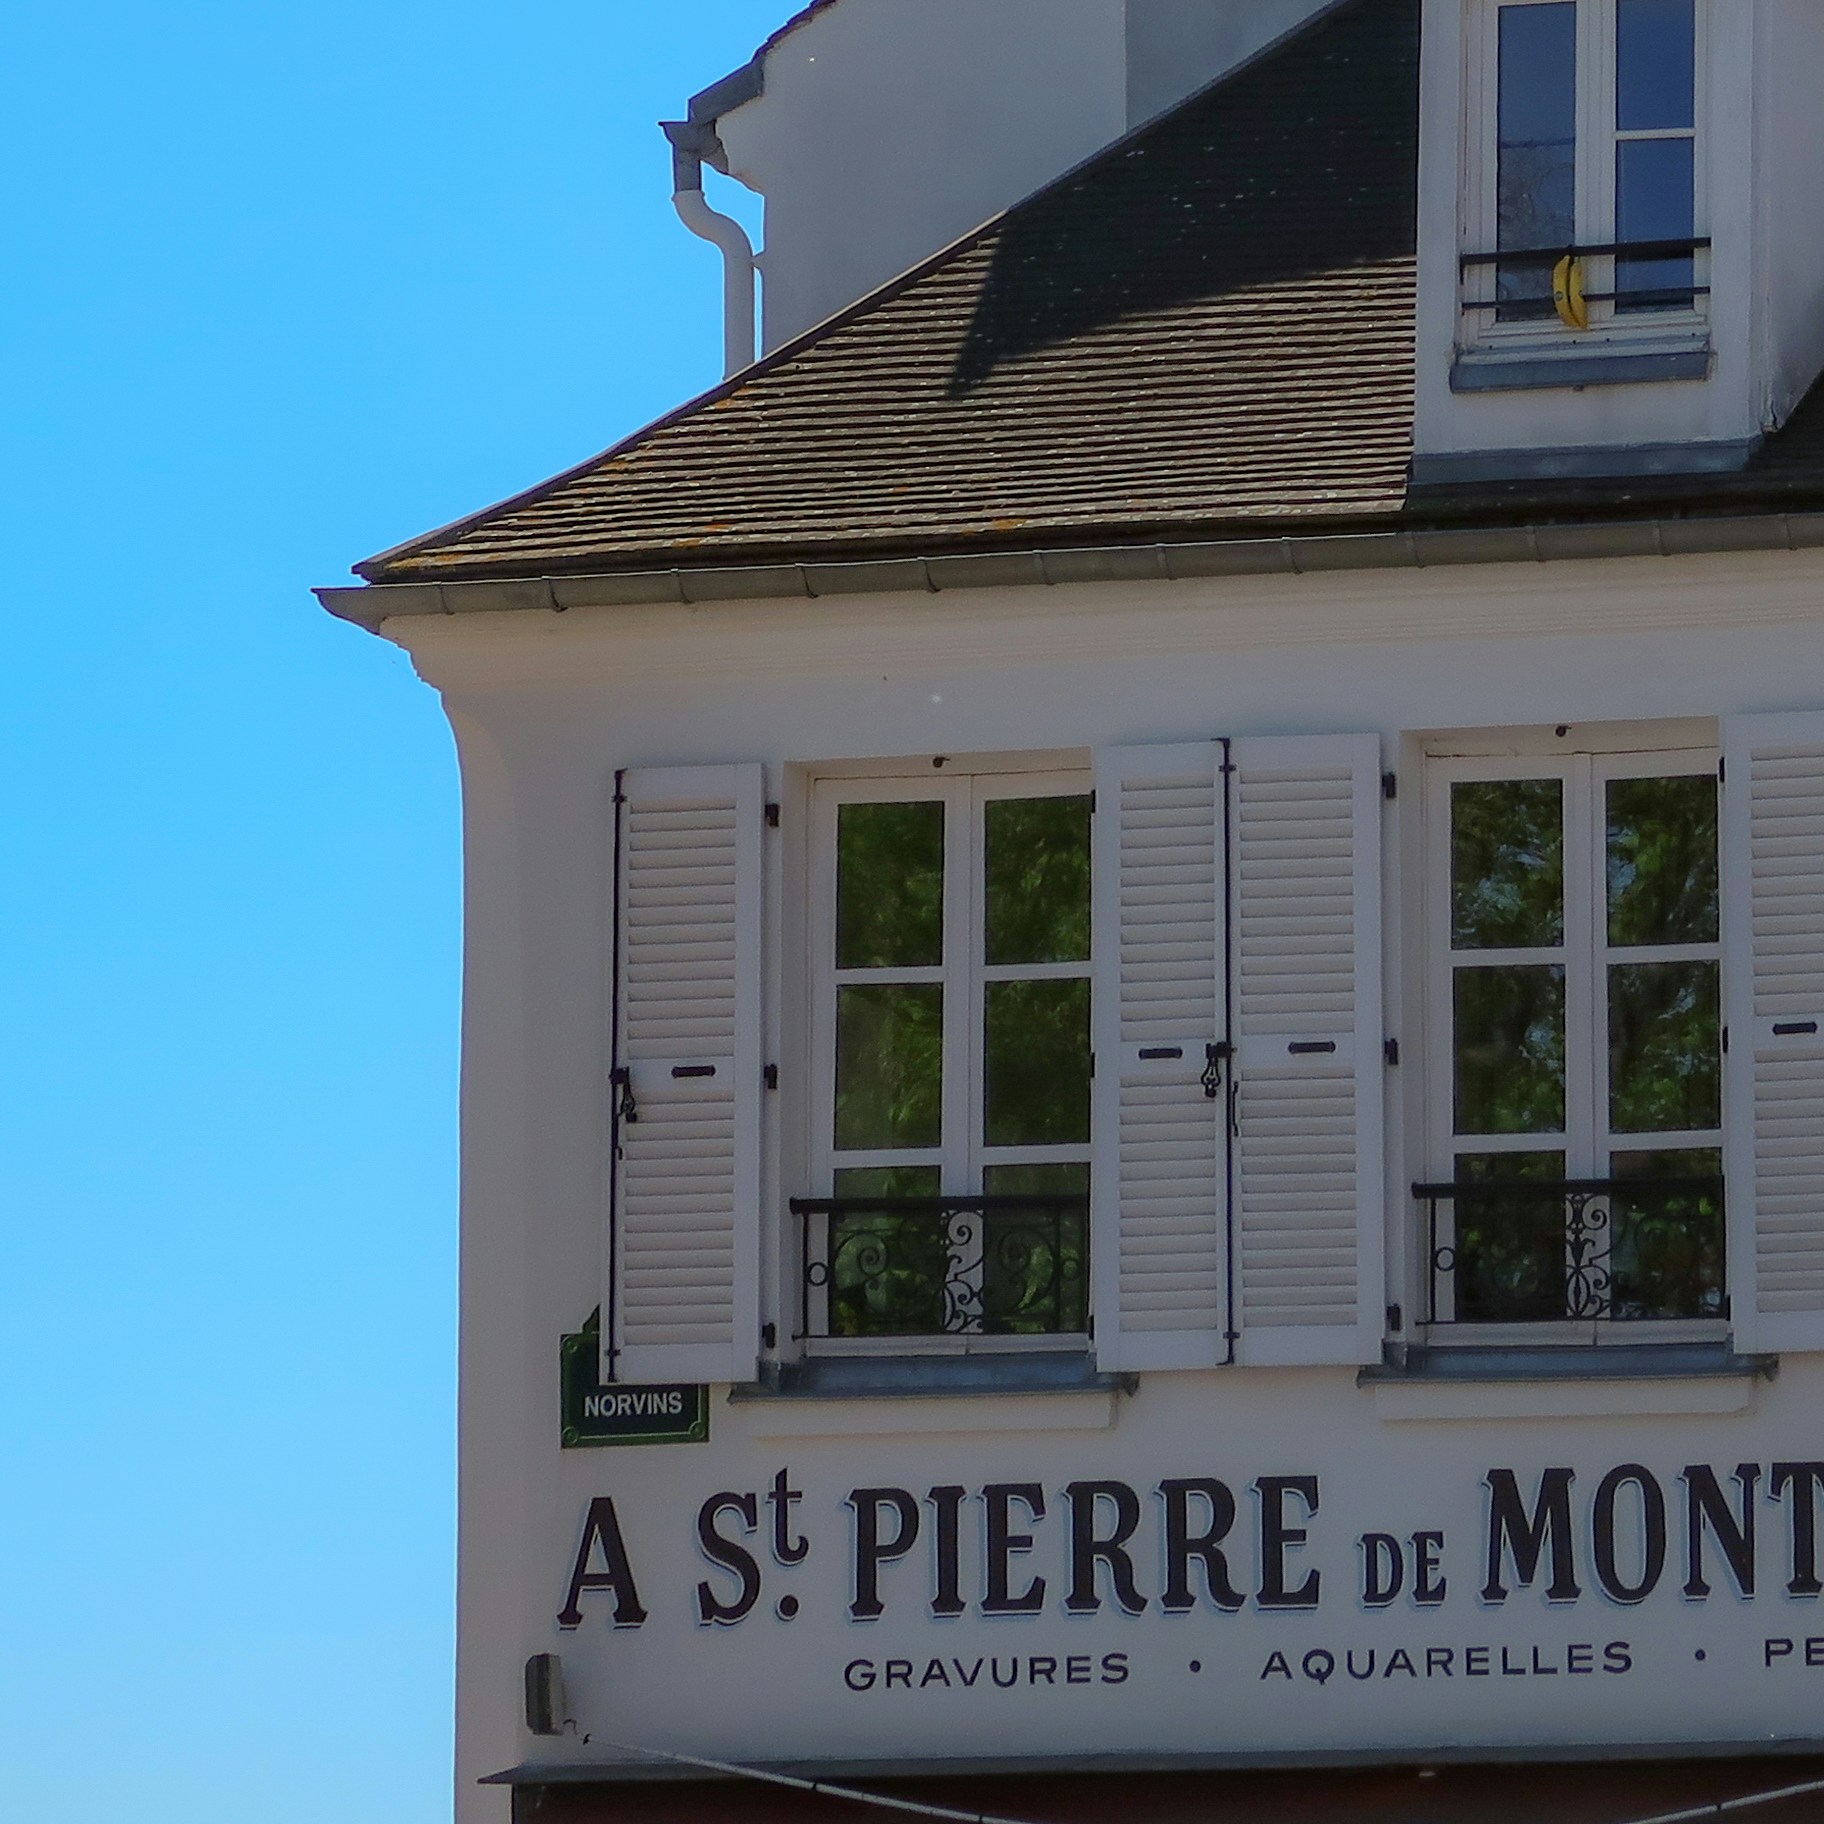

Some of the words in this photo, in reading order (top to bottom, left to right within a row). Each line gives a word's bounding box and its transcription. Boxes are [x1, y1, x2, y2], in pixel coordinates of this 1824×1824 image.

[584, 1391, 683, 1418] NORVINS
[557, 1496, 649, 1632] A
[843, 1475, 1321, 1624] PIERRE
[1360, 1530, 1448, 1610] DE
[844, 1653, 1129, 1692] GRAVURES
[1260, 1641, 1633, 1686] AQUARELLES
